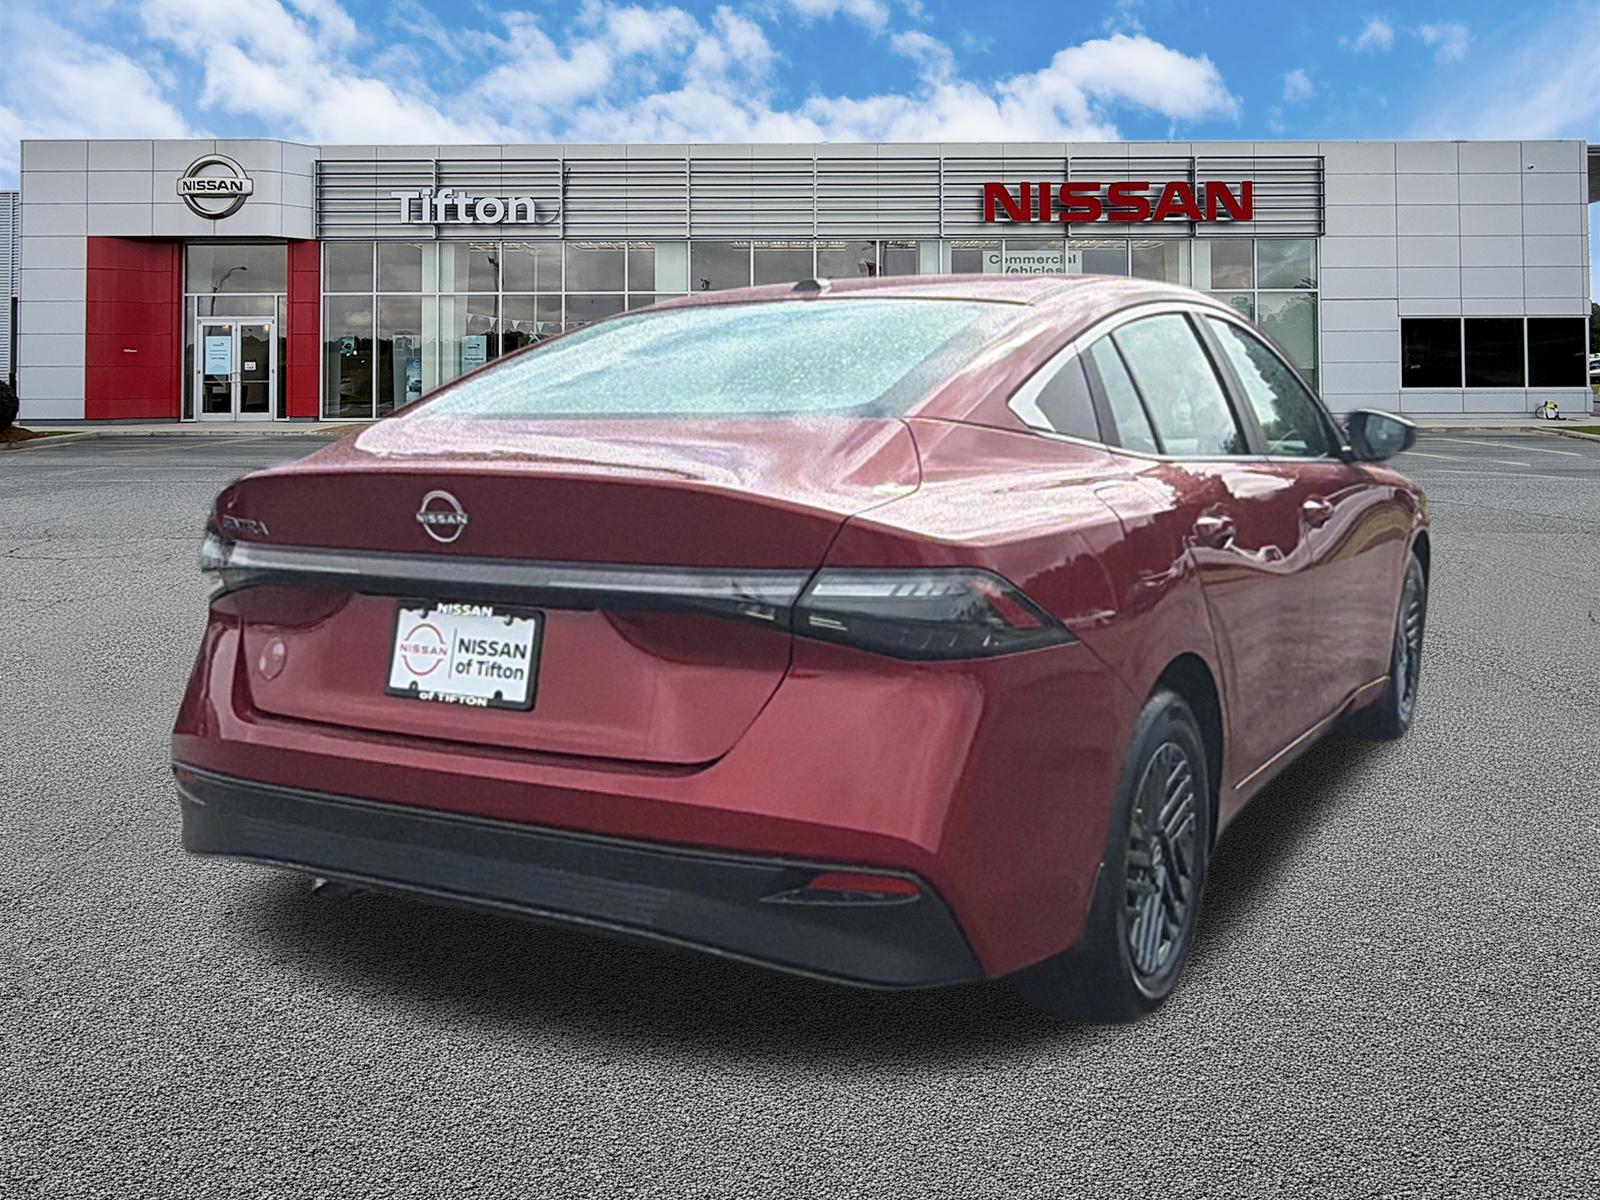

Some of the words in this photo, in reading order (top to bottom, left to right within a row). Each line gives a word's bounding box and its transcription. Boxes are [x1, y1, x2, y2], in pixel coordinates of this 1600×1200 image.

[182, 180, 243, 191] NISSAN
[391, 188, 536, 224] Tifton
[984, 181, 1253, 222] NISSAN
[437, 603, 493, 617] NISSAN
[400, 643, 448, 656] NISSAN
[458, 638, 528, 659] NISSAN
[455, 659, 473, 674] of
[477, 661, 524, 680] Tifton
[437, 692, 489, 707] TIFTON
